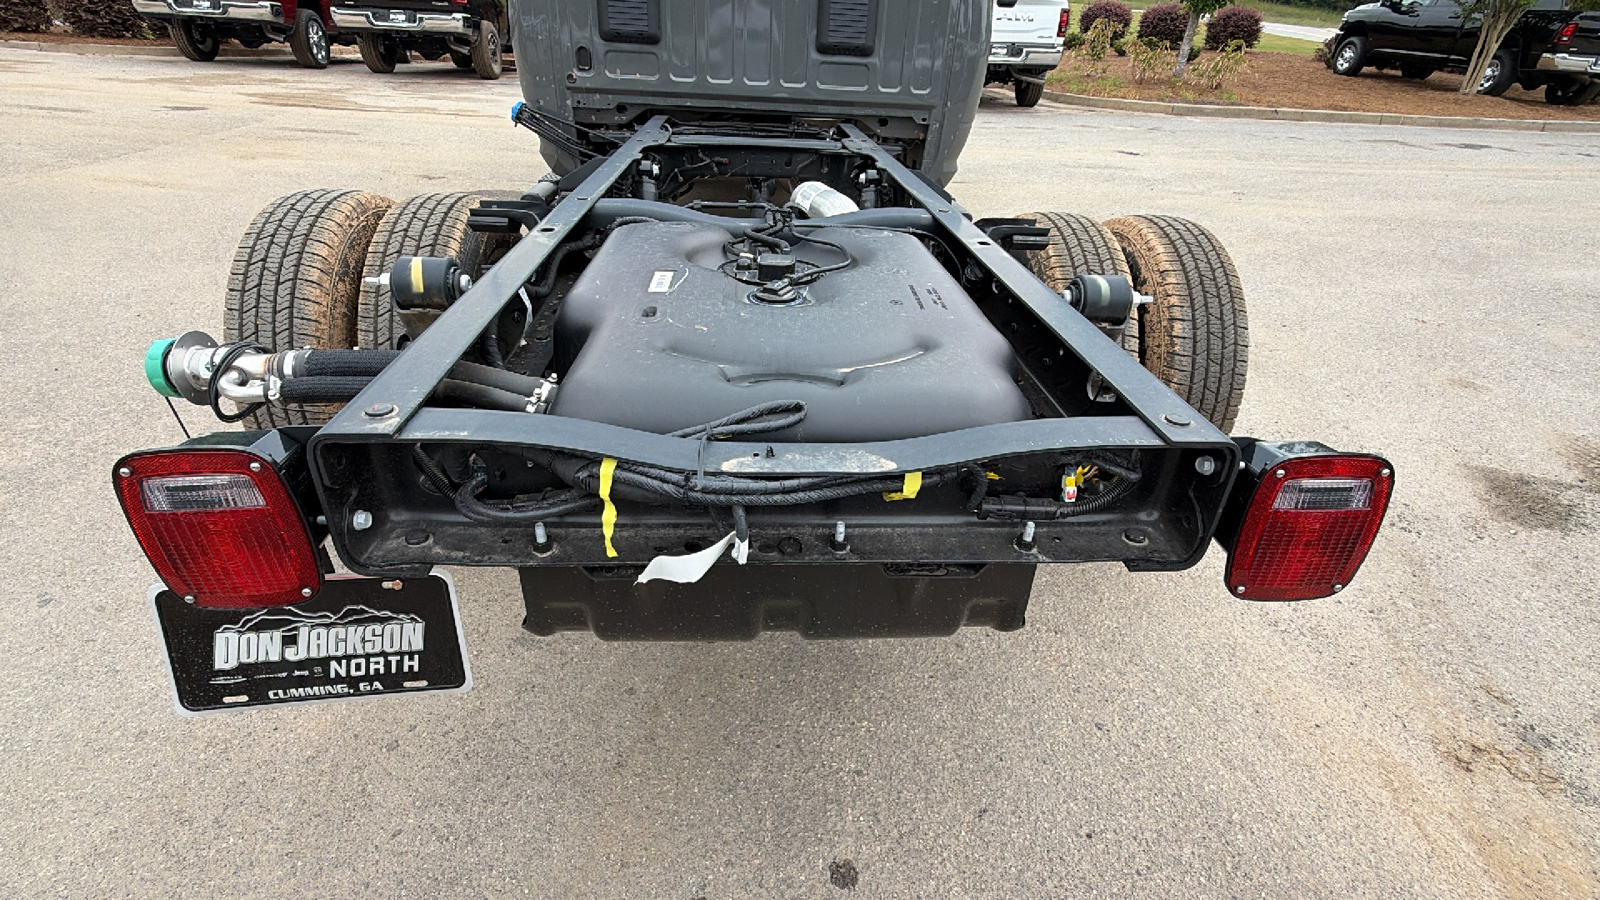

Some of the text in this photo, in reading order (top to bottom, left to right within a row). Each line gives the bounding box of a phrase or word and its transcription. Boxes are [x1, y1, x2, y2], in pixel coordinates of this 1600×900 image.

[213, 622, 425, 671] DON JACKSON
[329, 655, 420, 678] NORTH
[268, 681, 384, 699] CUMMING, GA
